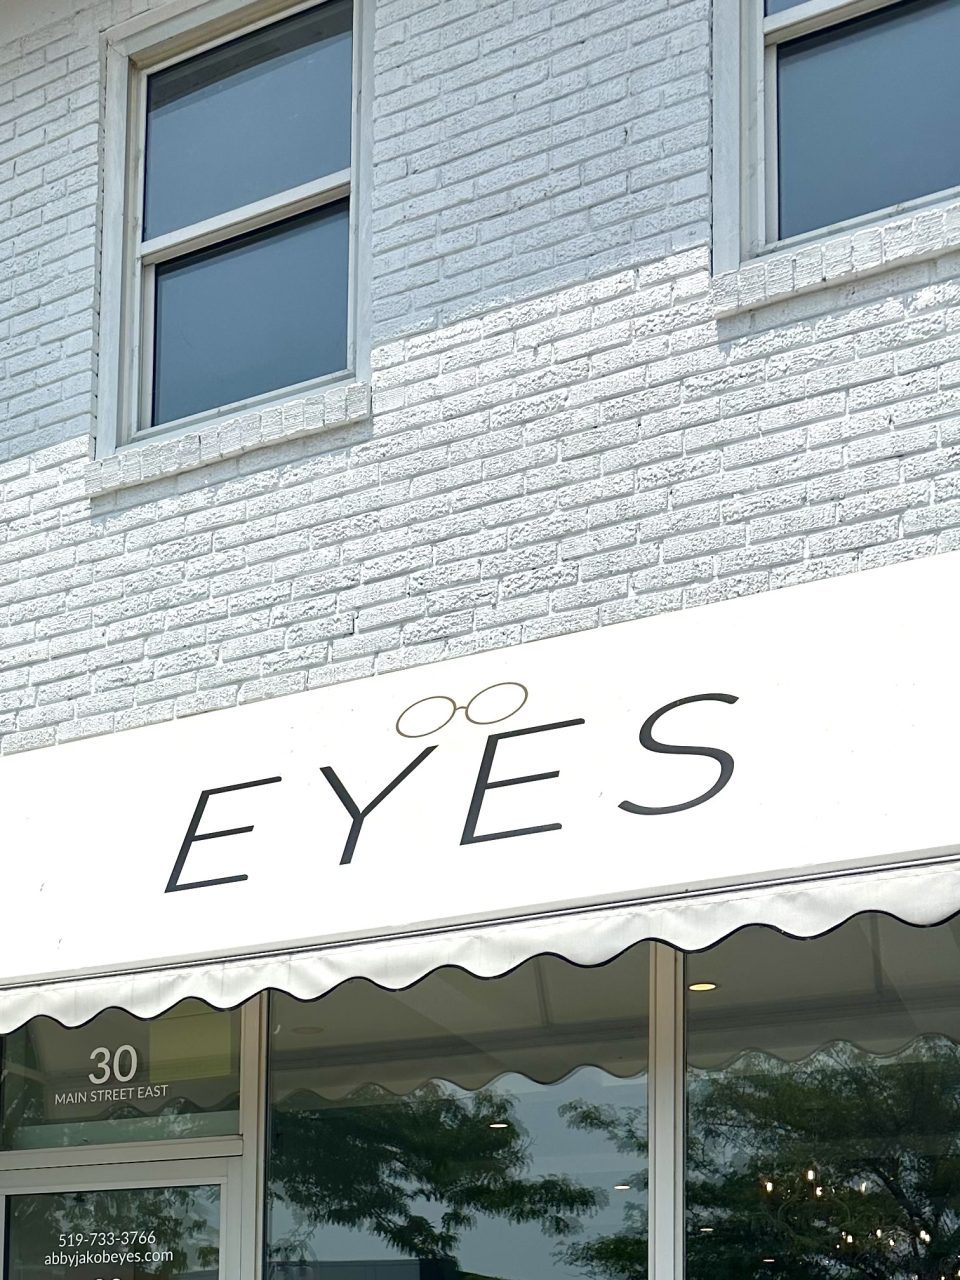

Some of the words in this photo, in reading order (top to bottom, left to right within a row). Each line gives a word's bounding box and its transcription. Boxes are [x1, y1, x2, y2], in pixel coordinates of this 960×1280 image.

[164, 692, 739, 893] EYES
[88, 1044, 138, 1085] 30
[54, 1092, 87, 1105] MAIN
[90, 1087, 135, 1103] STREET
[137, 1084, 169, 1099] EAST
[58, 1230, 156, 1247] 519-733-3766
[44, 1249, 174, 1267] abbyjakobeyes.com
